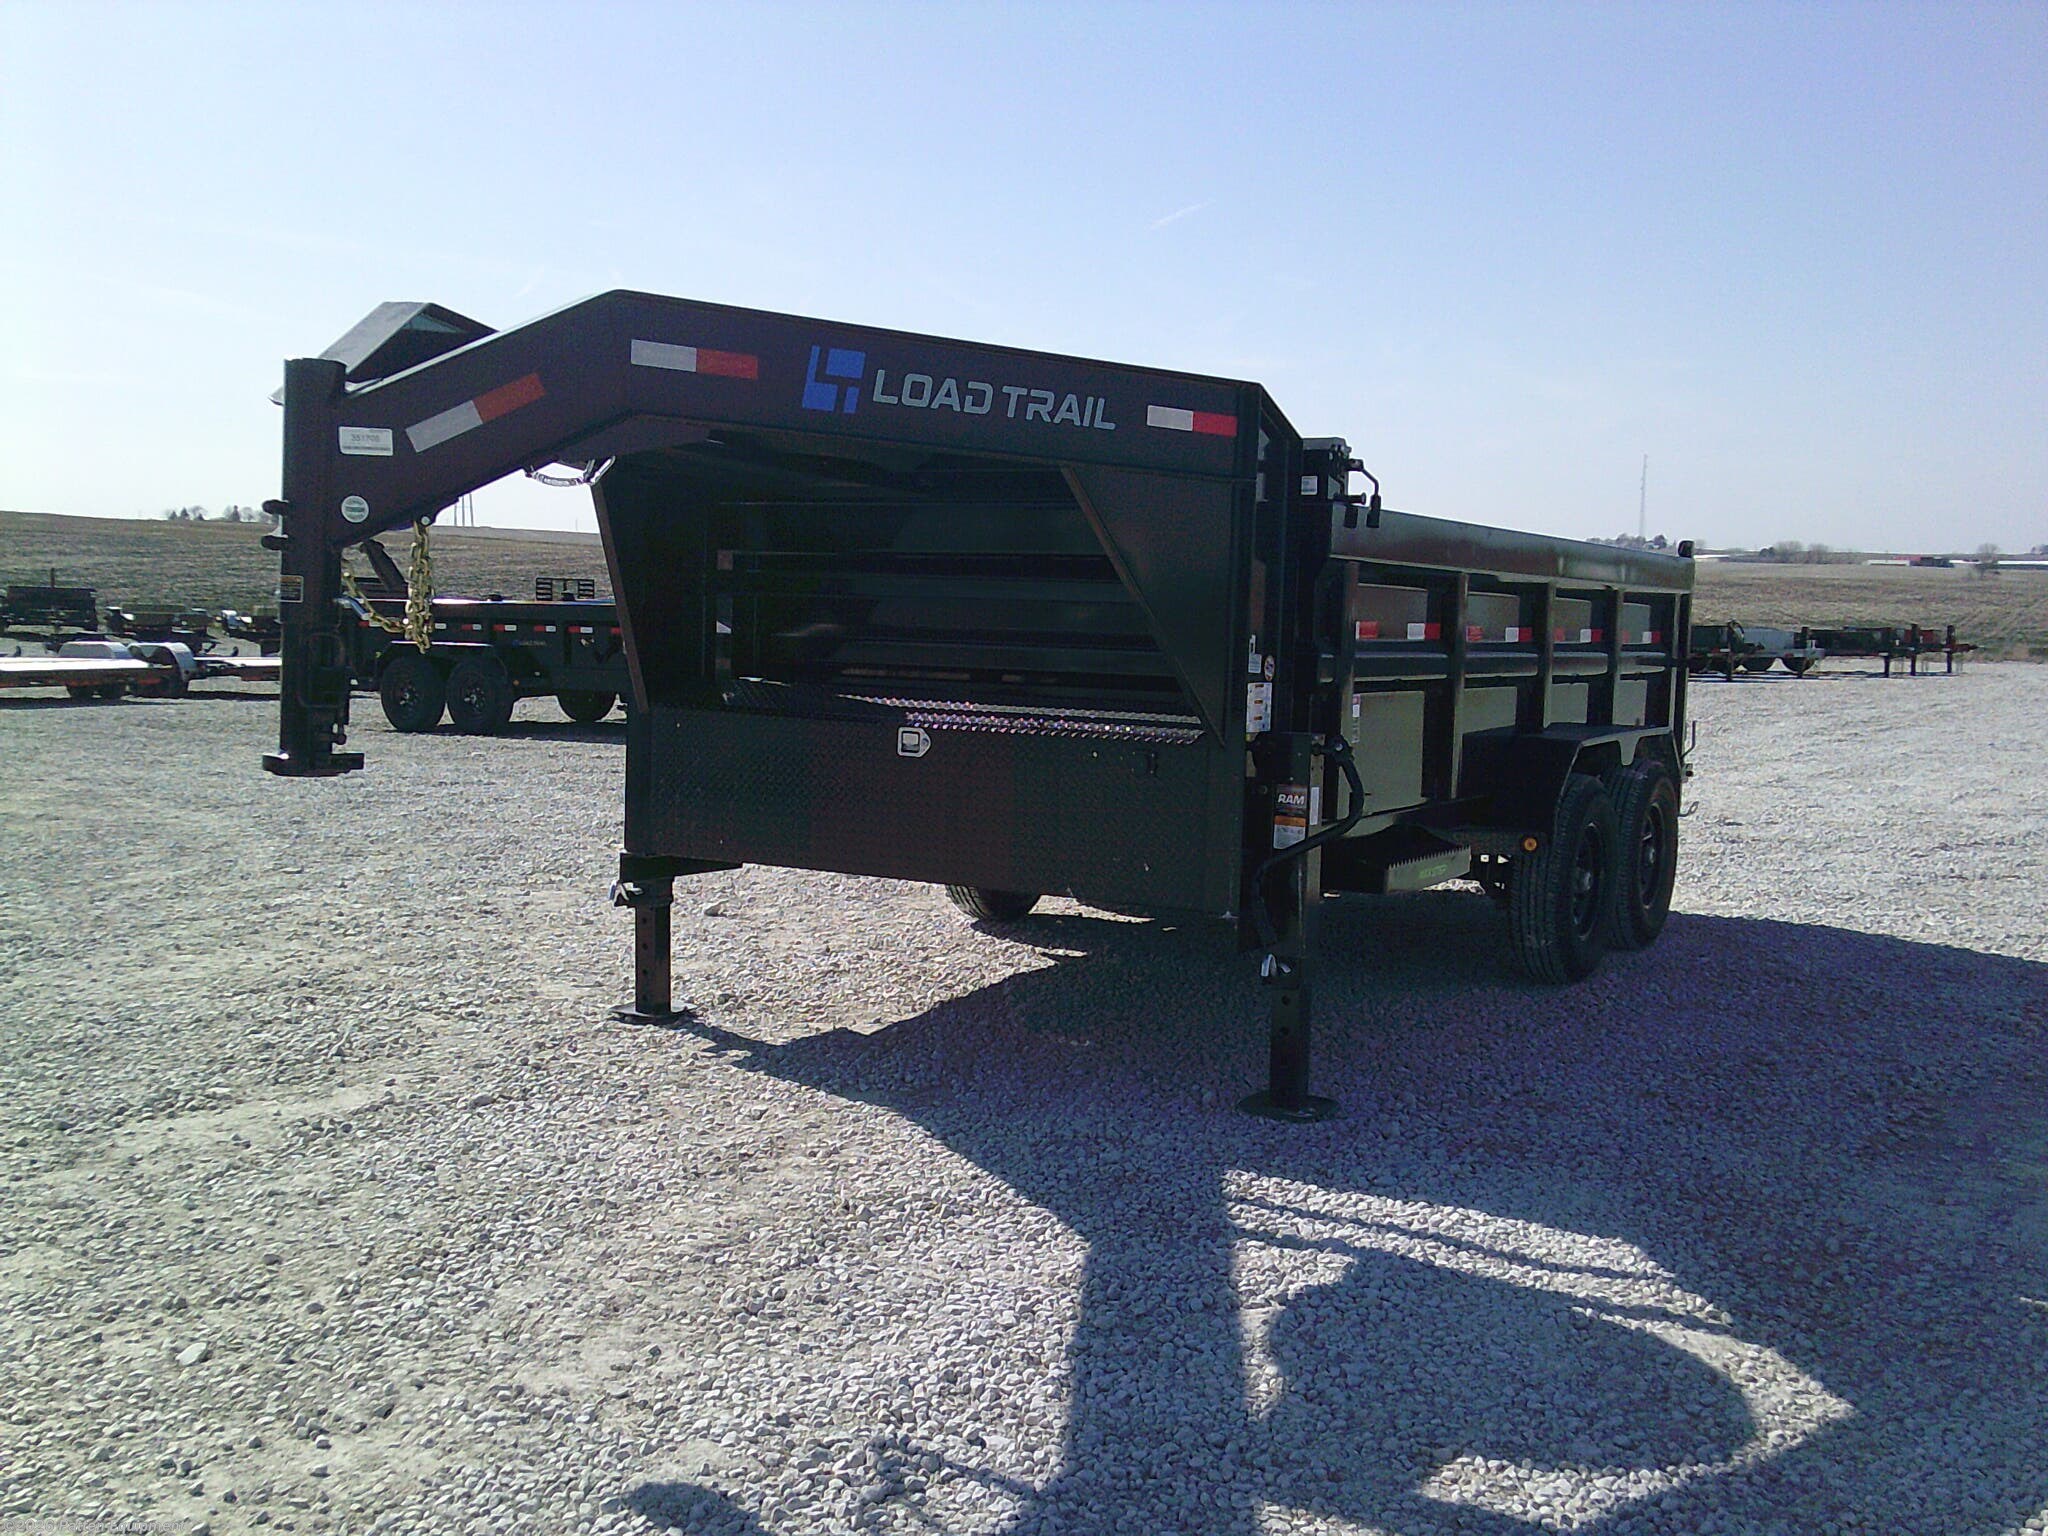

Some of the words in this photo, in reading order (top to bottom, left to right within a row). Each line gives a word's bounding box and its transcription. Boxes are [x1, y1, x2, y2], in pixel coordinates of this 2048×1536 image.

[873, 369, 993, 415] LOAD
[1002, 386, 1115, 430] TRAIL
[1277, 793, 1305, 805] RAM
